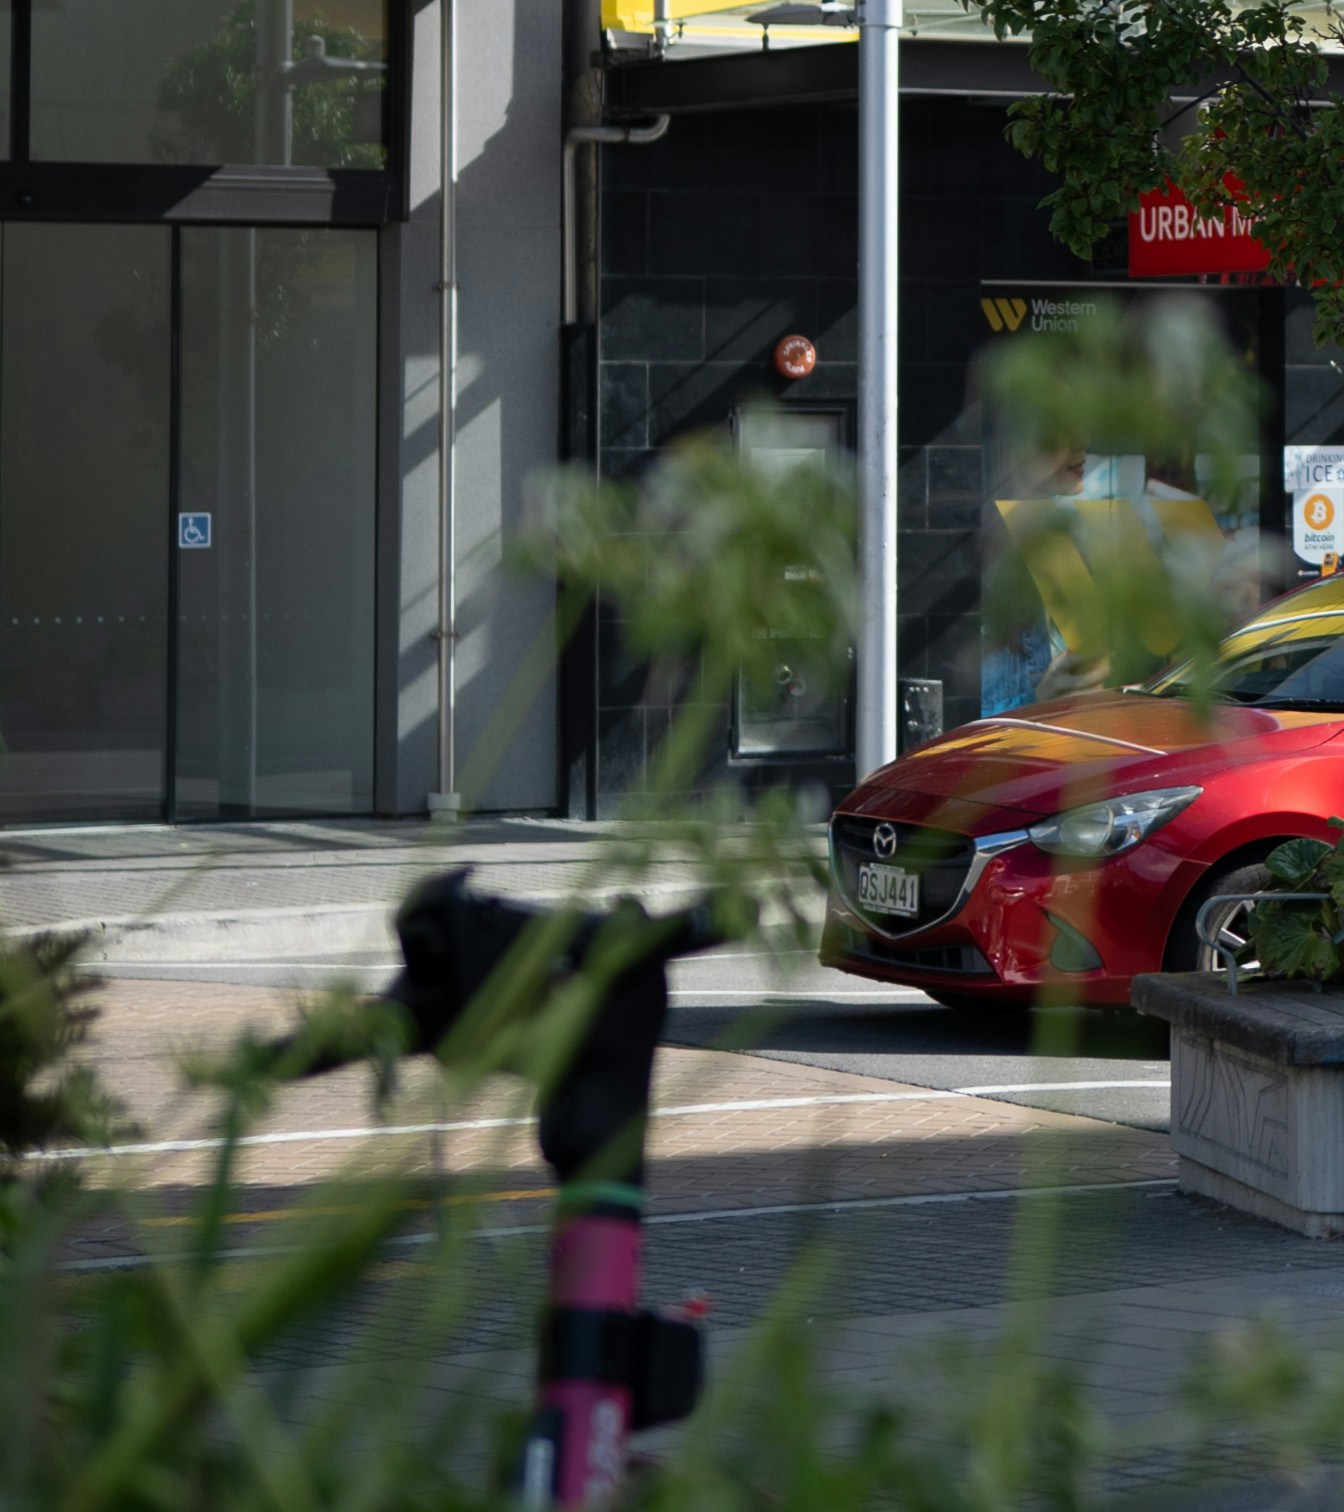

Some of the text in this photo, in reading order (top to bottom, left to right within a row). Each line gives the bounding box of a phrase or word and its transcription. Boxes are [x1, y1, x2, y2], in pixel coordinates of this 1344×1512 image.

[1031, 299, 1096, 315] Western
[1032, 316, 1079, 333] Union
[1306, 465, 1333, 482] ICE
[861, 871, 915, 909] QSJ441
